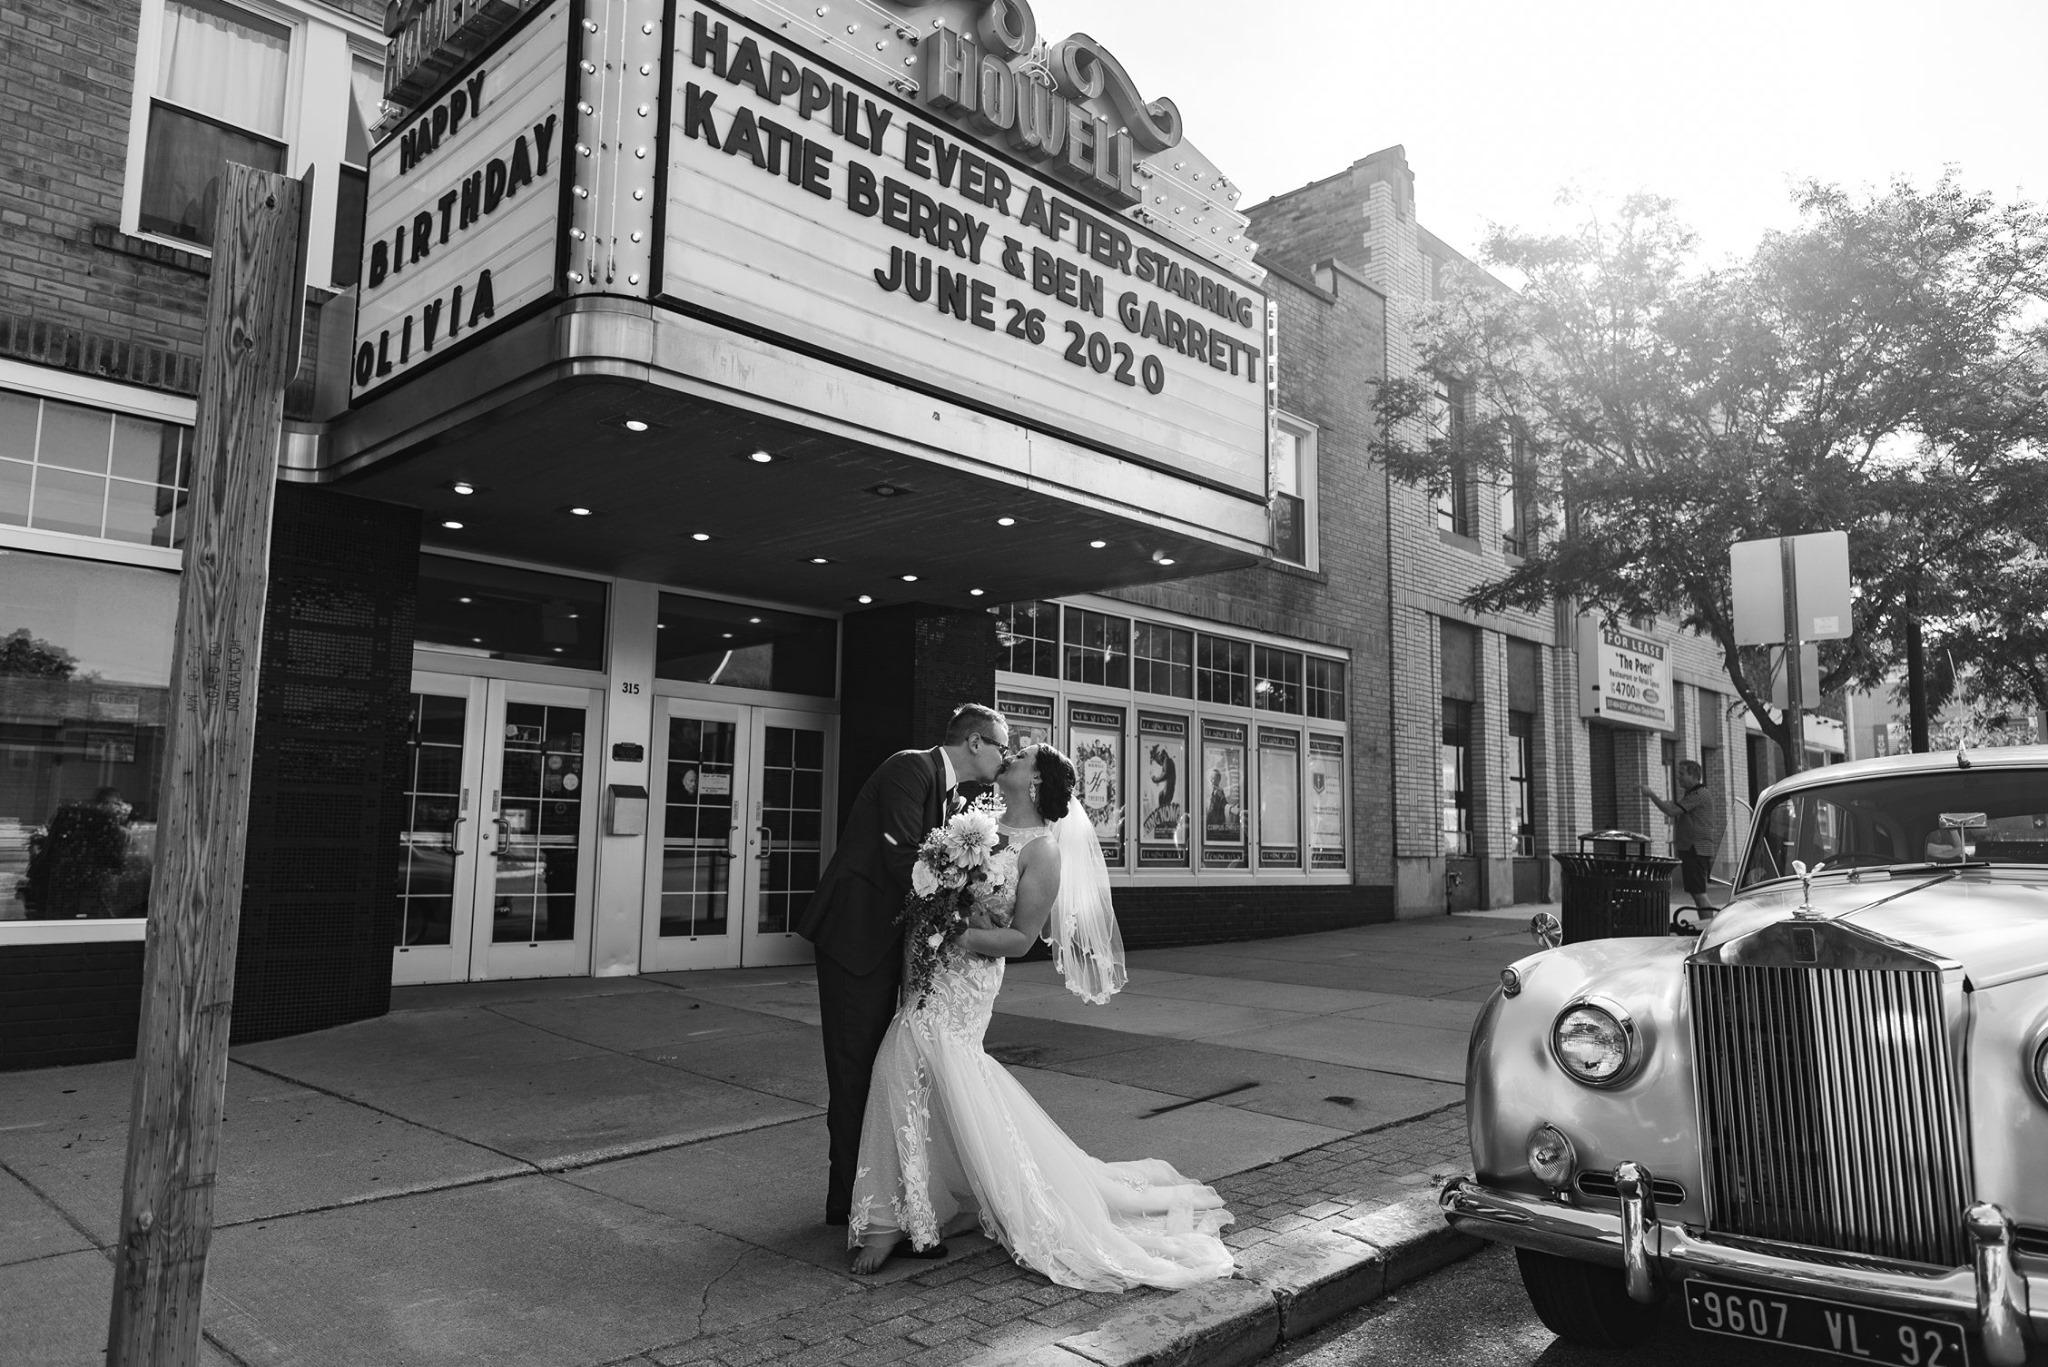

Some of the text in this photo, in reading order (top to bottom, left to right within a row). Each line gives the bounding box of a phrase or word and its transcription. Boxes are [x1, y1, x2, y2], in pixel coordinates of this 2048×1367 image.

[400, 69, 487, 176] HAPPY
[692, 10, 1254, 329] HAPPILY EVER AFTER STARRING
[930, 26, 1142, 208] HOWELL
[368, 113, 558, 289] BIRTHDAY
[684, 82, 1261, 384] KATIE BERRY & BEN GARRETT
[355, 268, 496, 388] OLIVIA
[873, 245, 1166, 395] JUNE 26 2020
[622, 682, 640, 695] 315
[1607, 631, 1661, 658] FOR LEASE
[1703, 1291, 1944, 1367] 9607 VL 92
